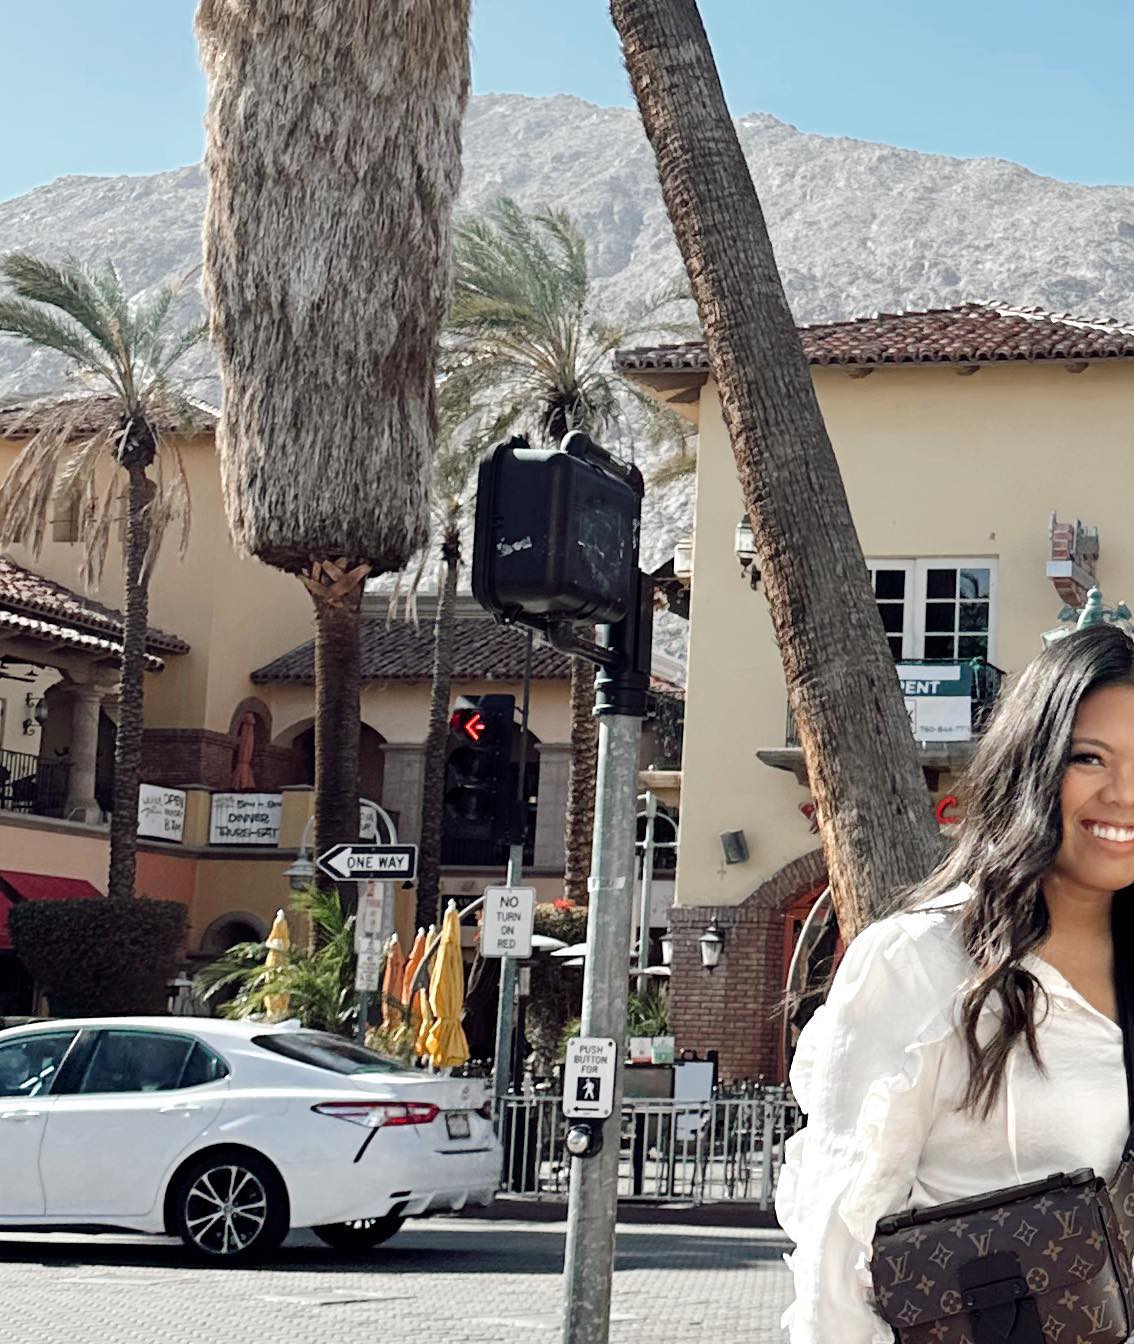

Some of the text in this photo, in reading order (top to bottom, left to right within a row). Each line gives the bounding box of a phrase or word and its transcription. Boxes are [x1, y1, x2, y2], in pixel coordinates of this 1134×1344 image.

[228, 813, 270, 823] DINNER
[347, 856, 404, 869] ONE WAY
[500, 896, 518, 908] NO
[496, 912, 521, 922] TURN
[501, 925, 514, 935] ON
[497, 939, 516, 949] RED
[579, 1045, 604, 1054] PUSH
[573, 1055, 608, 1064] BUTTON
[581, 1065, 599, 1074] FOR
